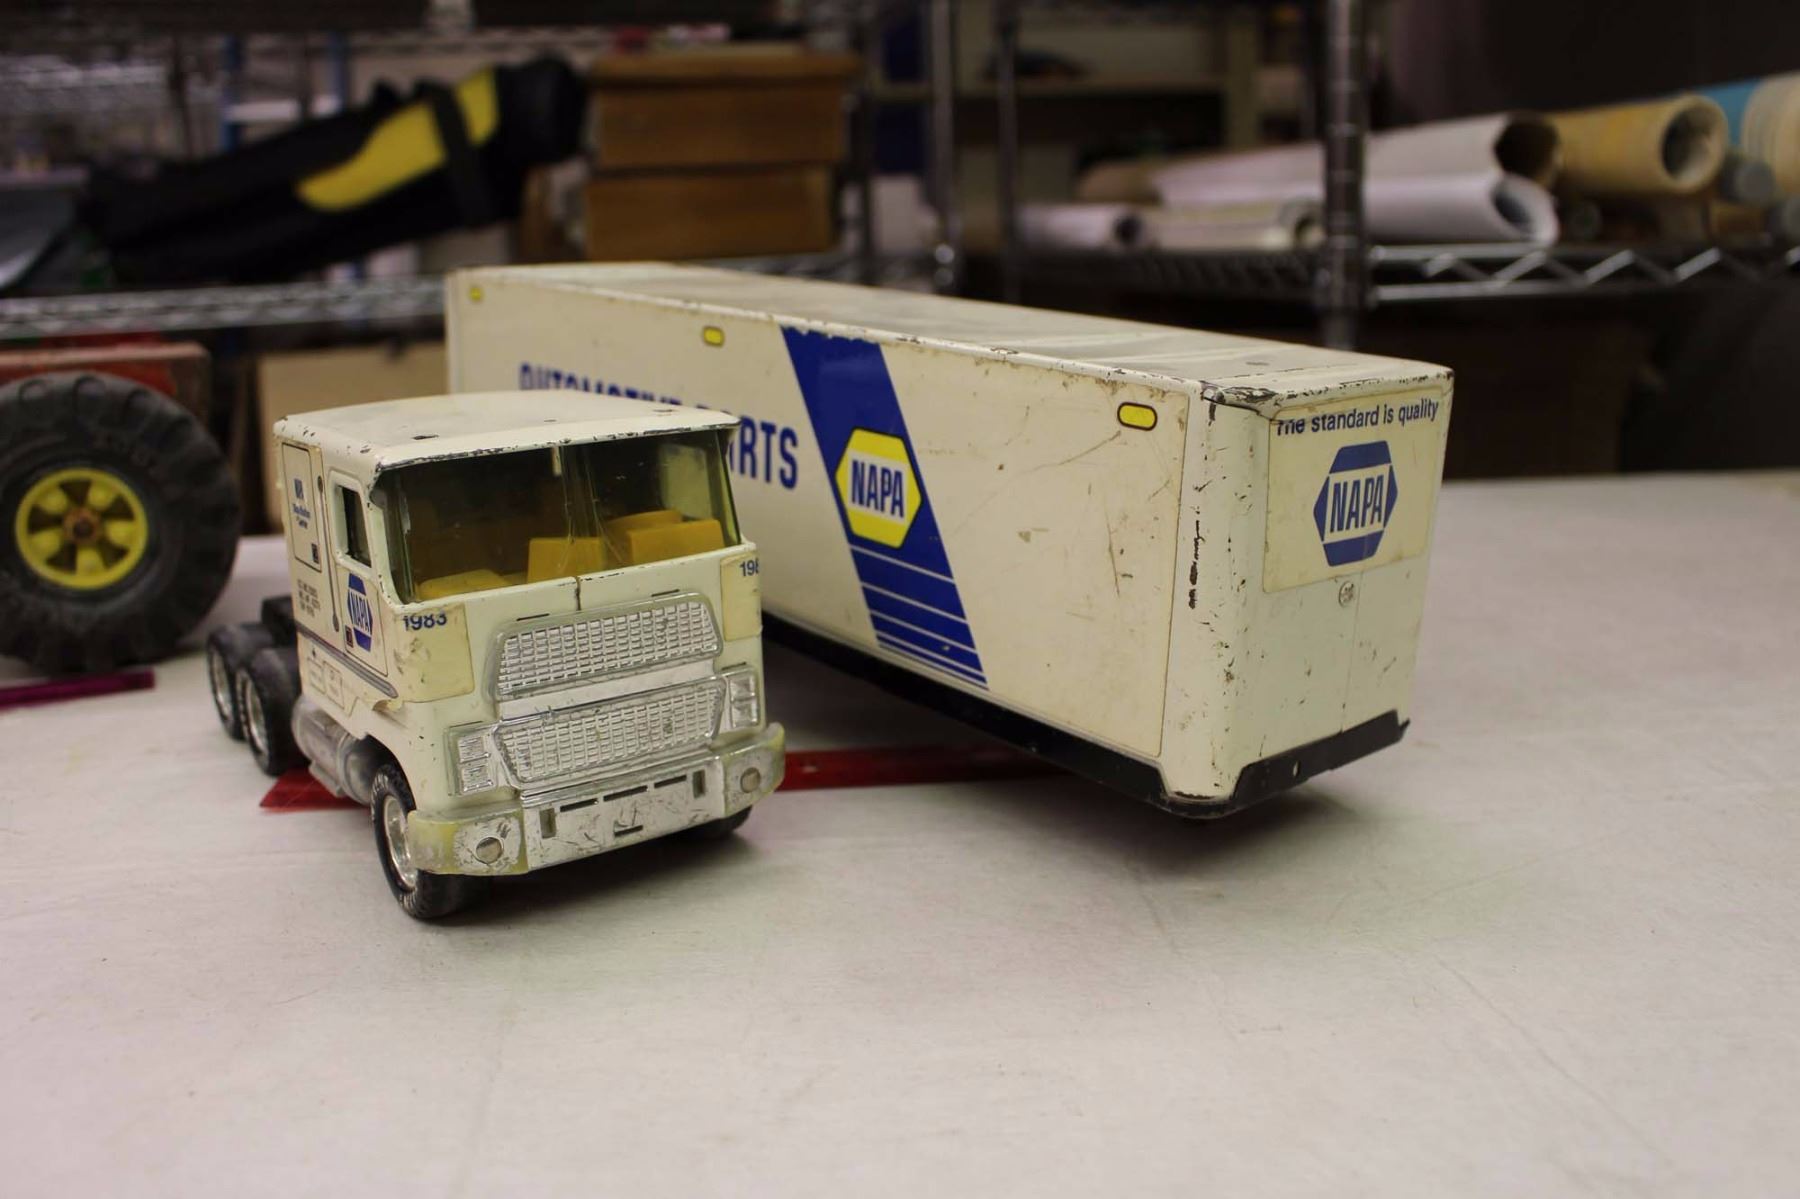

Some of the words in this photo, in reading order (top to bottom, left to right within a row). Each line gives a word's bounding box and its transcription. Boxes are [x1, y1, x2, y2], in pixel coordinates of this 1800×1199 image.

[1277, 417, 1305, 436] The
[1311, 405, 1380, 433] standard
[1383, 404, 1394, 424] is
[1399, 398, 1439, 426] quality
[696, 404, 798, 490] RTS
[851, 459, 904, 518] NAPA
[1329, 474, 1385, 533] NAPA
[740, 558, 759, 576] 19
[350, 590, 370, 633] NAPA
[403, 612, 447, 631] 1983
